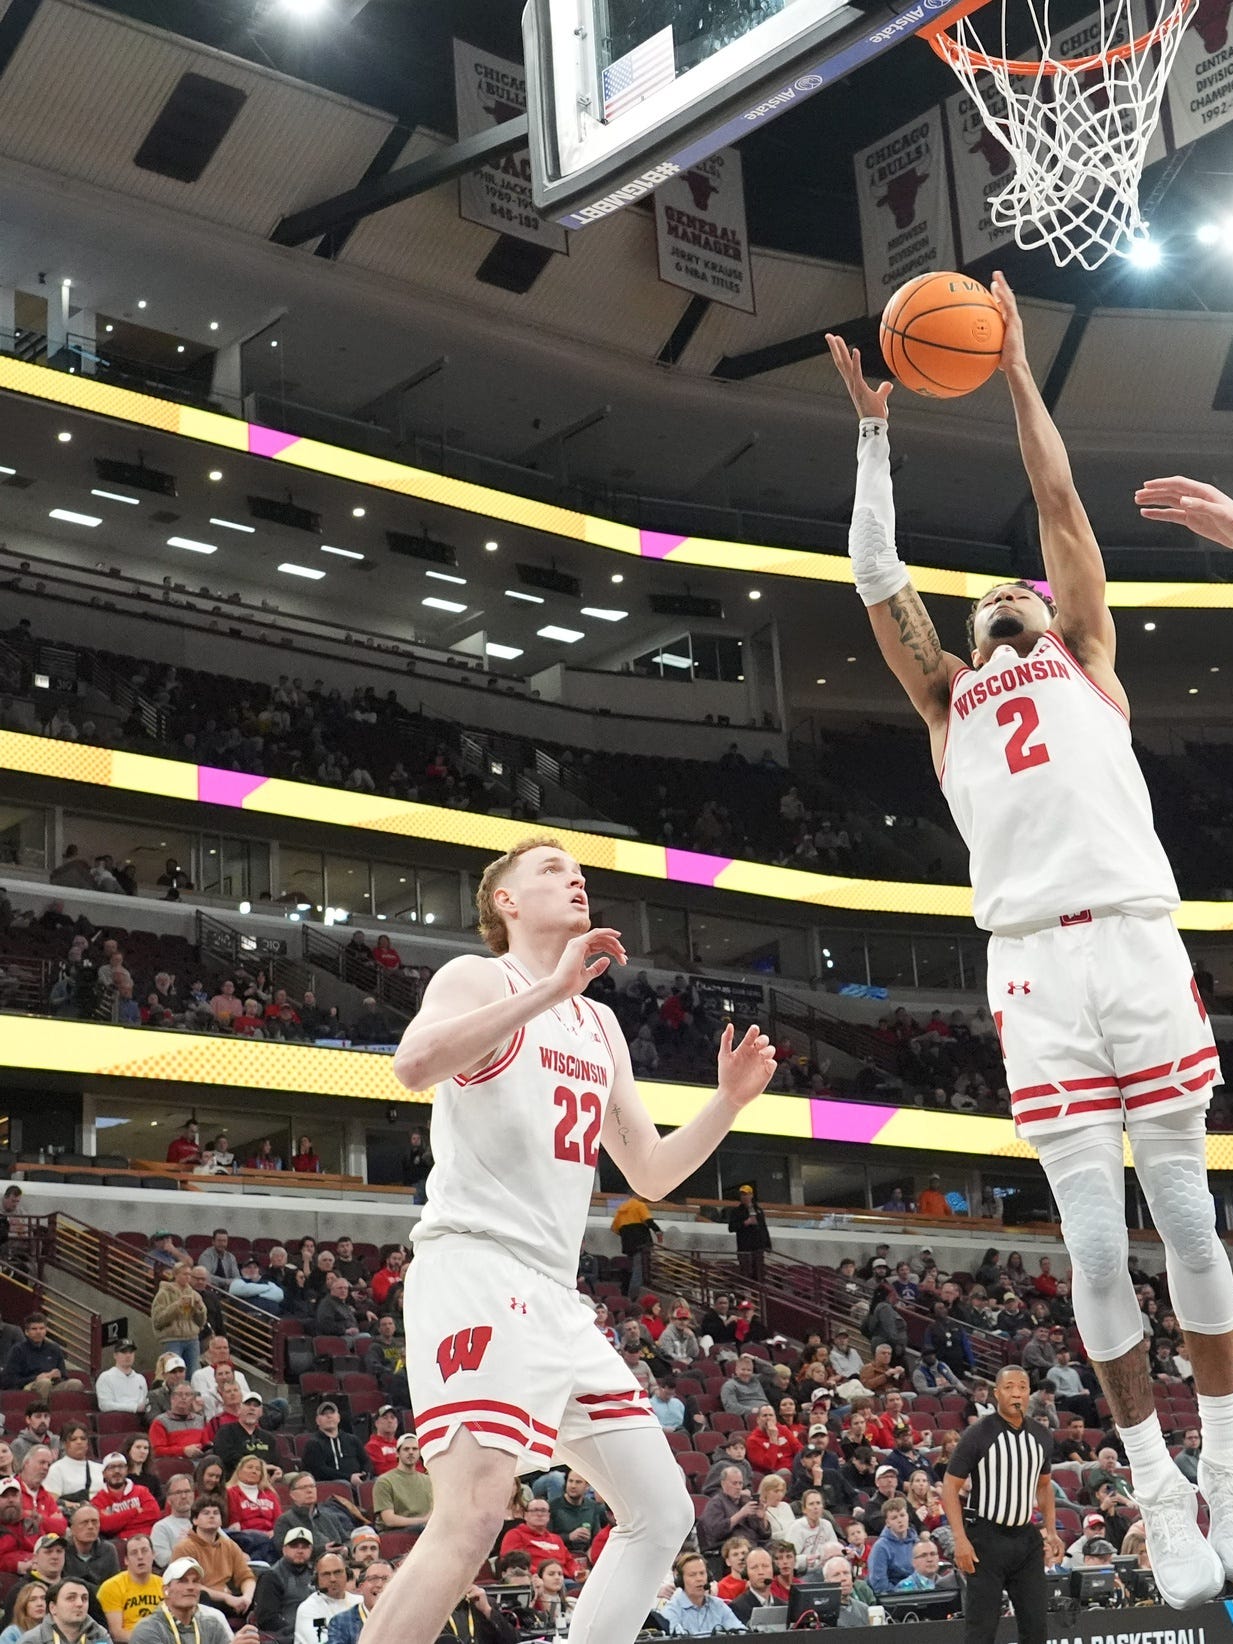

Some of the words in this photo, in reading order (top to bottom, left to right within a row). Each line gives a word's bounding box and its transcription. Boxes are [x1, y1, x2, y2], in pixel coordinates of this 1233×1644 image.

[869, 5, 925, 44] Allstate
[474, 63, 526, 90] CHICA
[744, 87, 797, 121] Allstate
[865, 122, 930, 170] CHICAGO
[878, 146, 926, 182] BULLS
[570, 161, 681, 225] #B1GMBBT
[665, 205, 742, 247] GENERAL
[667, 221, 742, 262] MANAGER
[953, 658, 1072, 721] WISCONSIN
[995, 696, 1050, 775] 2
[539, 1046, 608, 1088] WISCONSIN
[554, 1085, 602, 1168] 22
[436, 1326, 493, 1384] W
